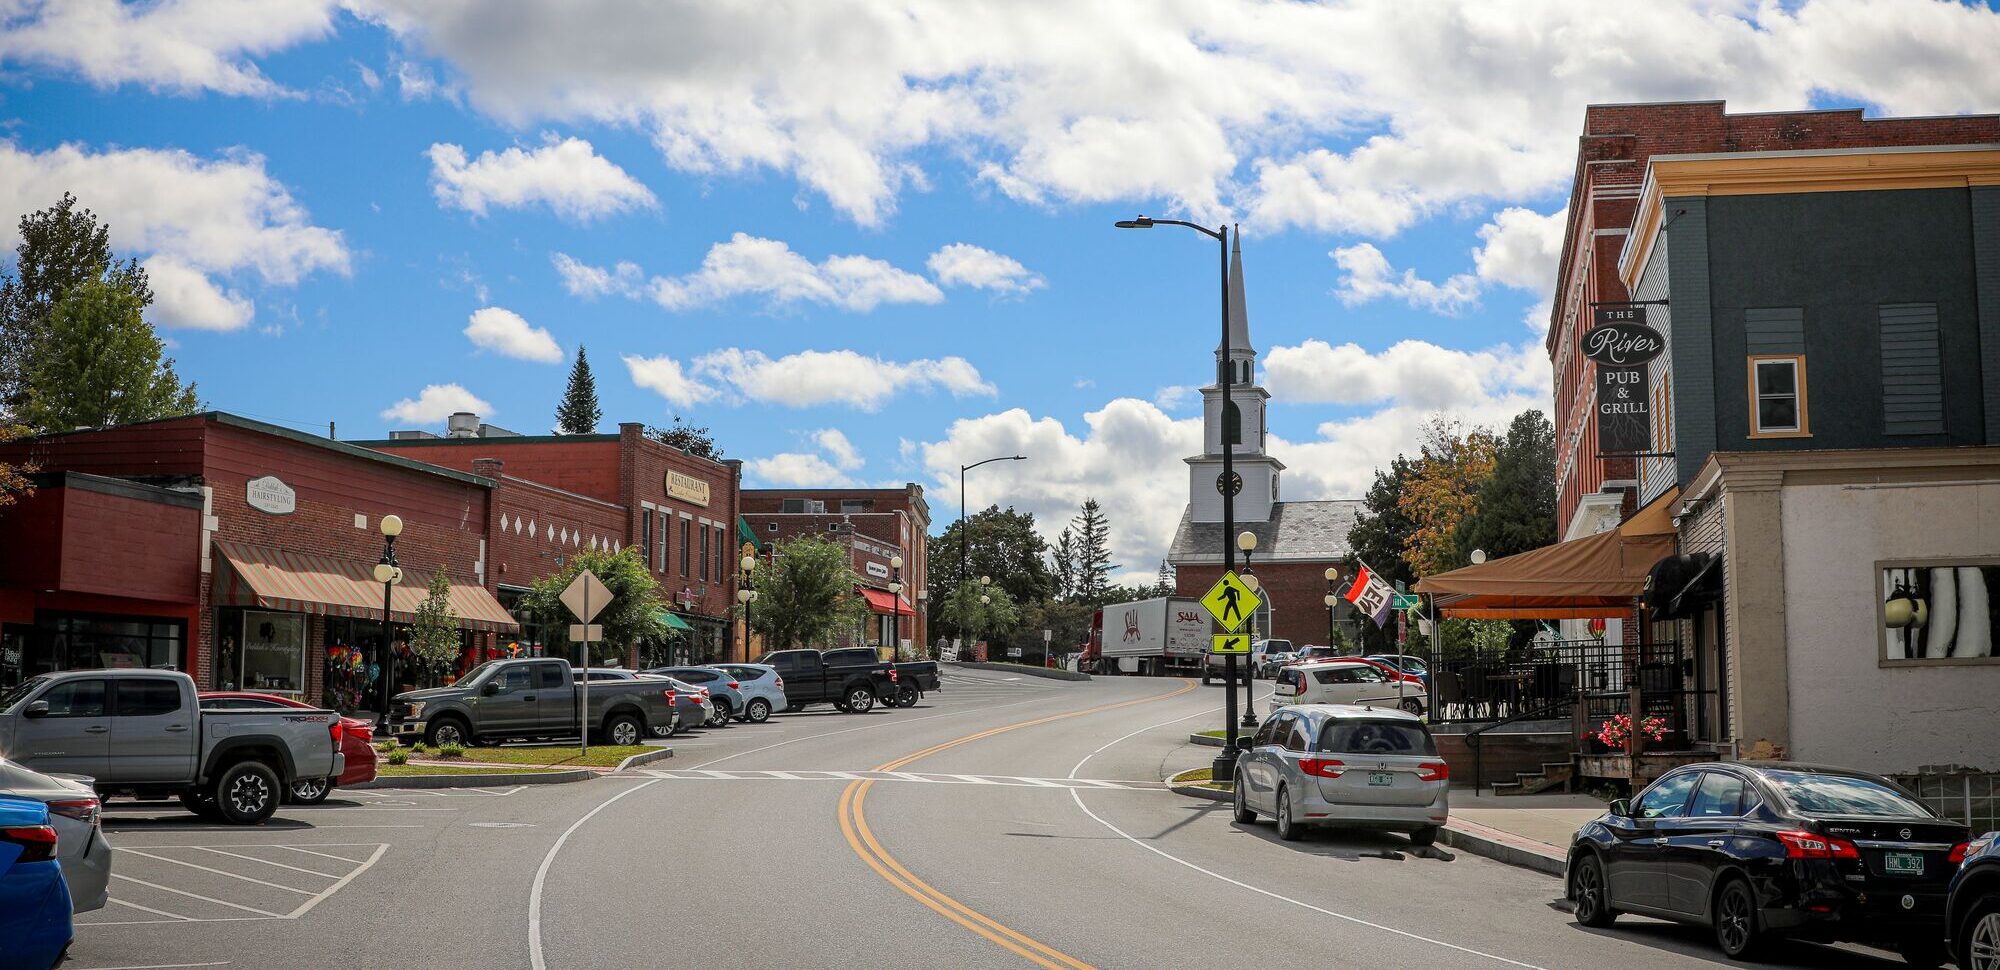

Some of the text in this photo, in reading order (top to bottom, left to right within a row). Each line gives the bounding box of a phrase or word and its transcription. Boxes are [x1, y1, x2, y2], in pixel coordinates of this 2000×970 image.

[1606, 311, 1634, 319] THE
[1587, 327, 1660, 363] River
[1605, 371, 1640, 385] PUB
[1617, 387, 1630, 399] &
[1600, 402, 1648, 414] GRILL
[671, 473, 705, 494] RESTAURANT
[252, 490, 291, 505] HAIRSTYLING
[1176, 612, 1204, 624] SAIA
[1888, 857, 1921, 869] HML 392
